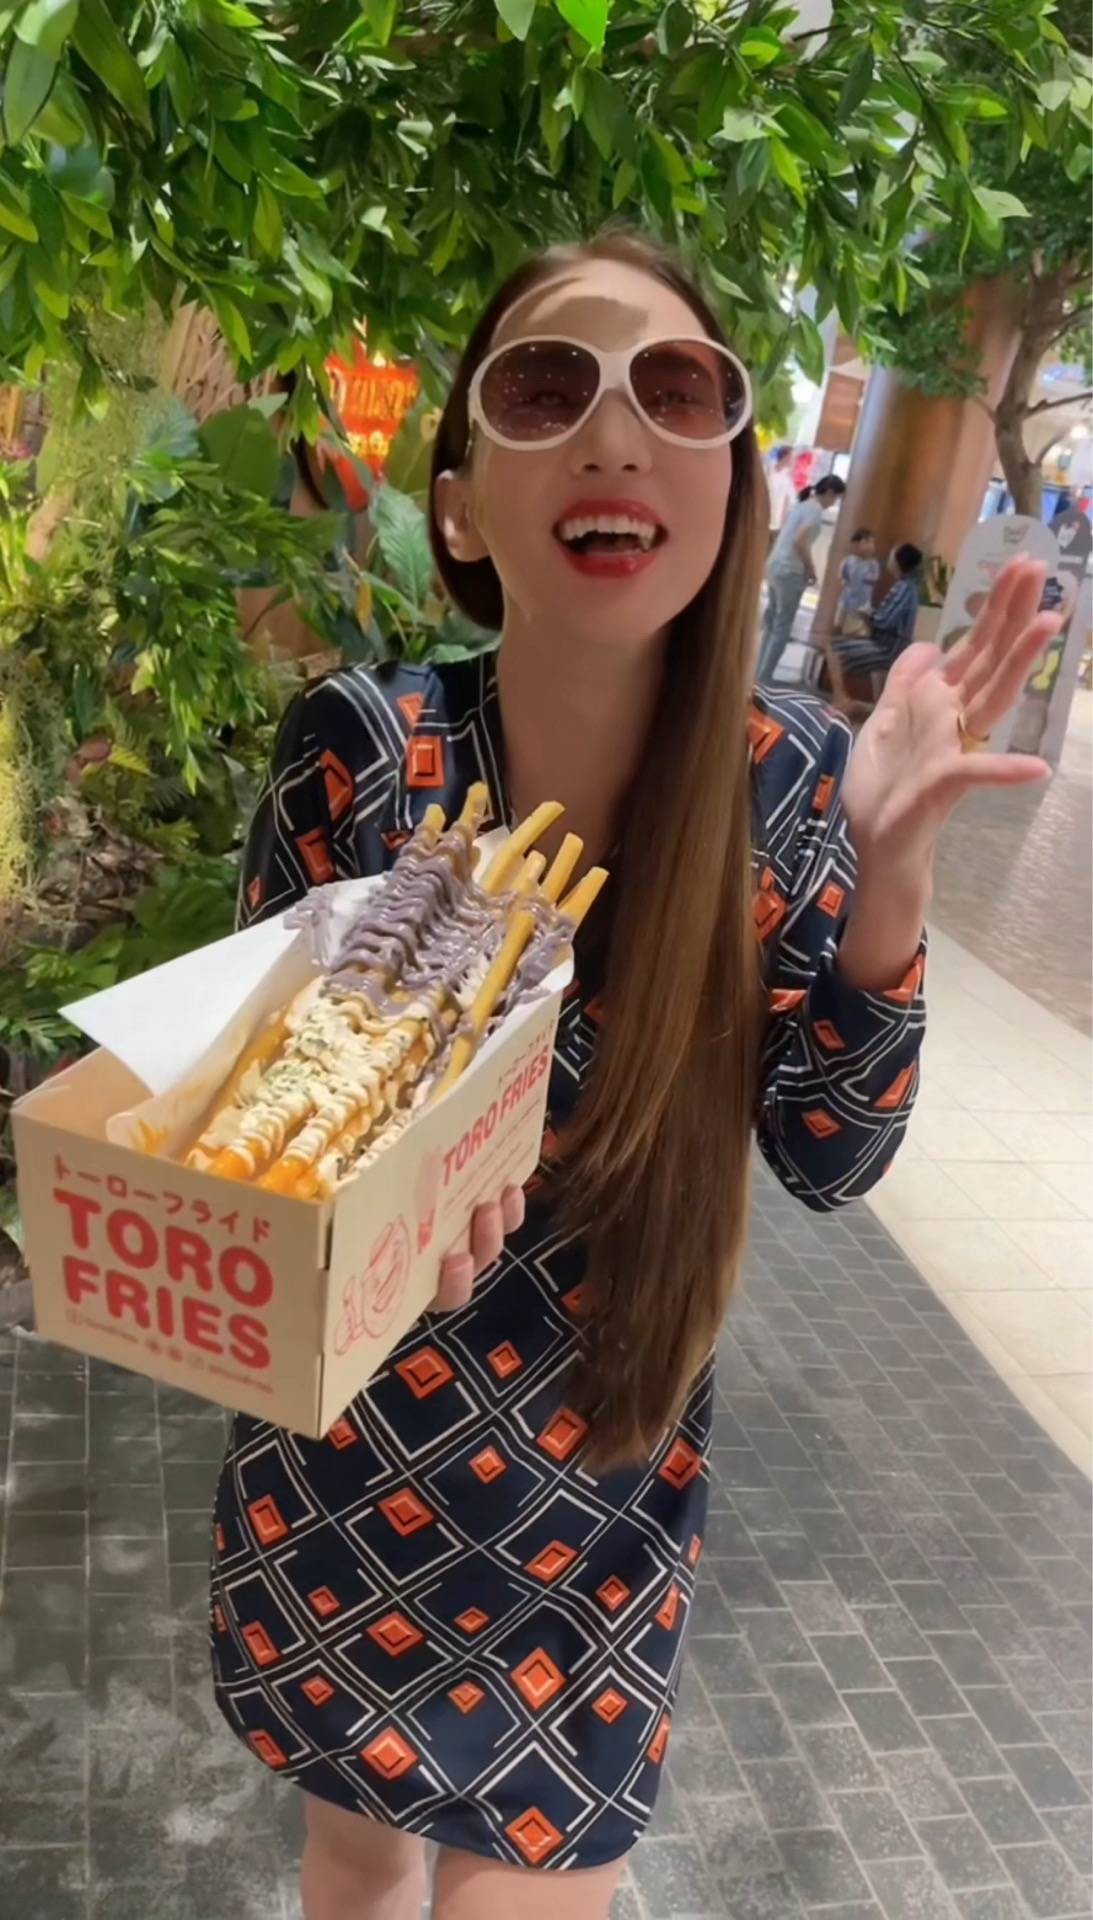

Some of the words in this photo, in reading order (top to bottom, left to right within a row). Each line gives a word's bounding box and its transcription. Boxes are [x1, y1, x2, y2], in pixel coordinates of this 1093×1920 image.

[442, 1101, 498, 1187] TORO
[500, 1044, 549, 1121] FRIES
[53, 1187, 274, 1308] TORO
[55, 1154, 271, 1242] トーローフライド
[63, 1255, 271, 1370] FRIES
